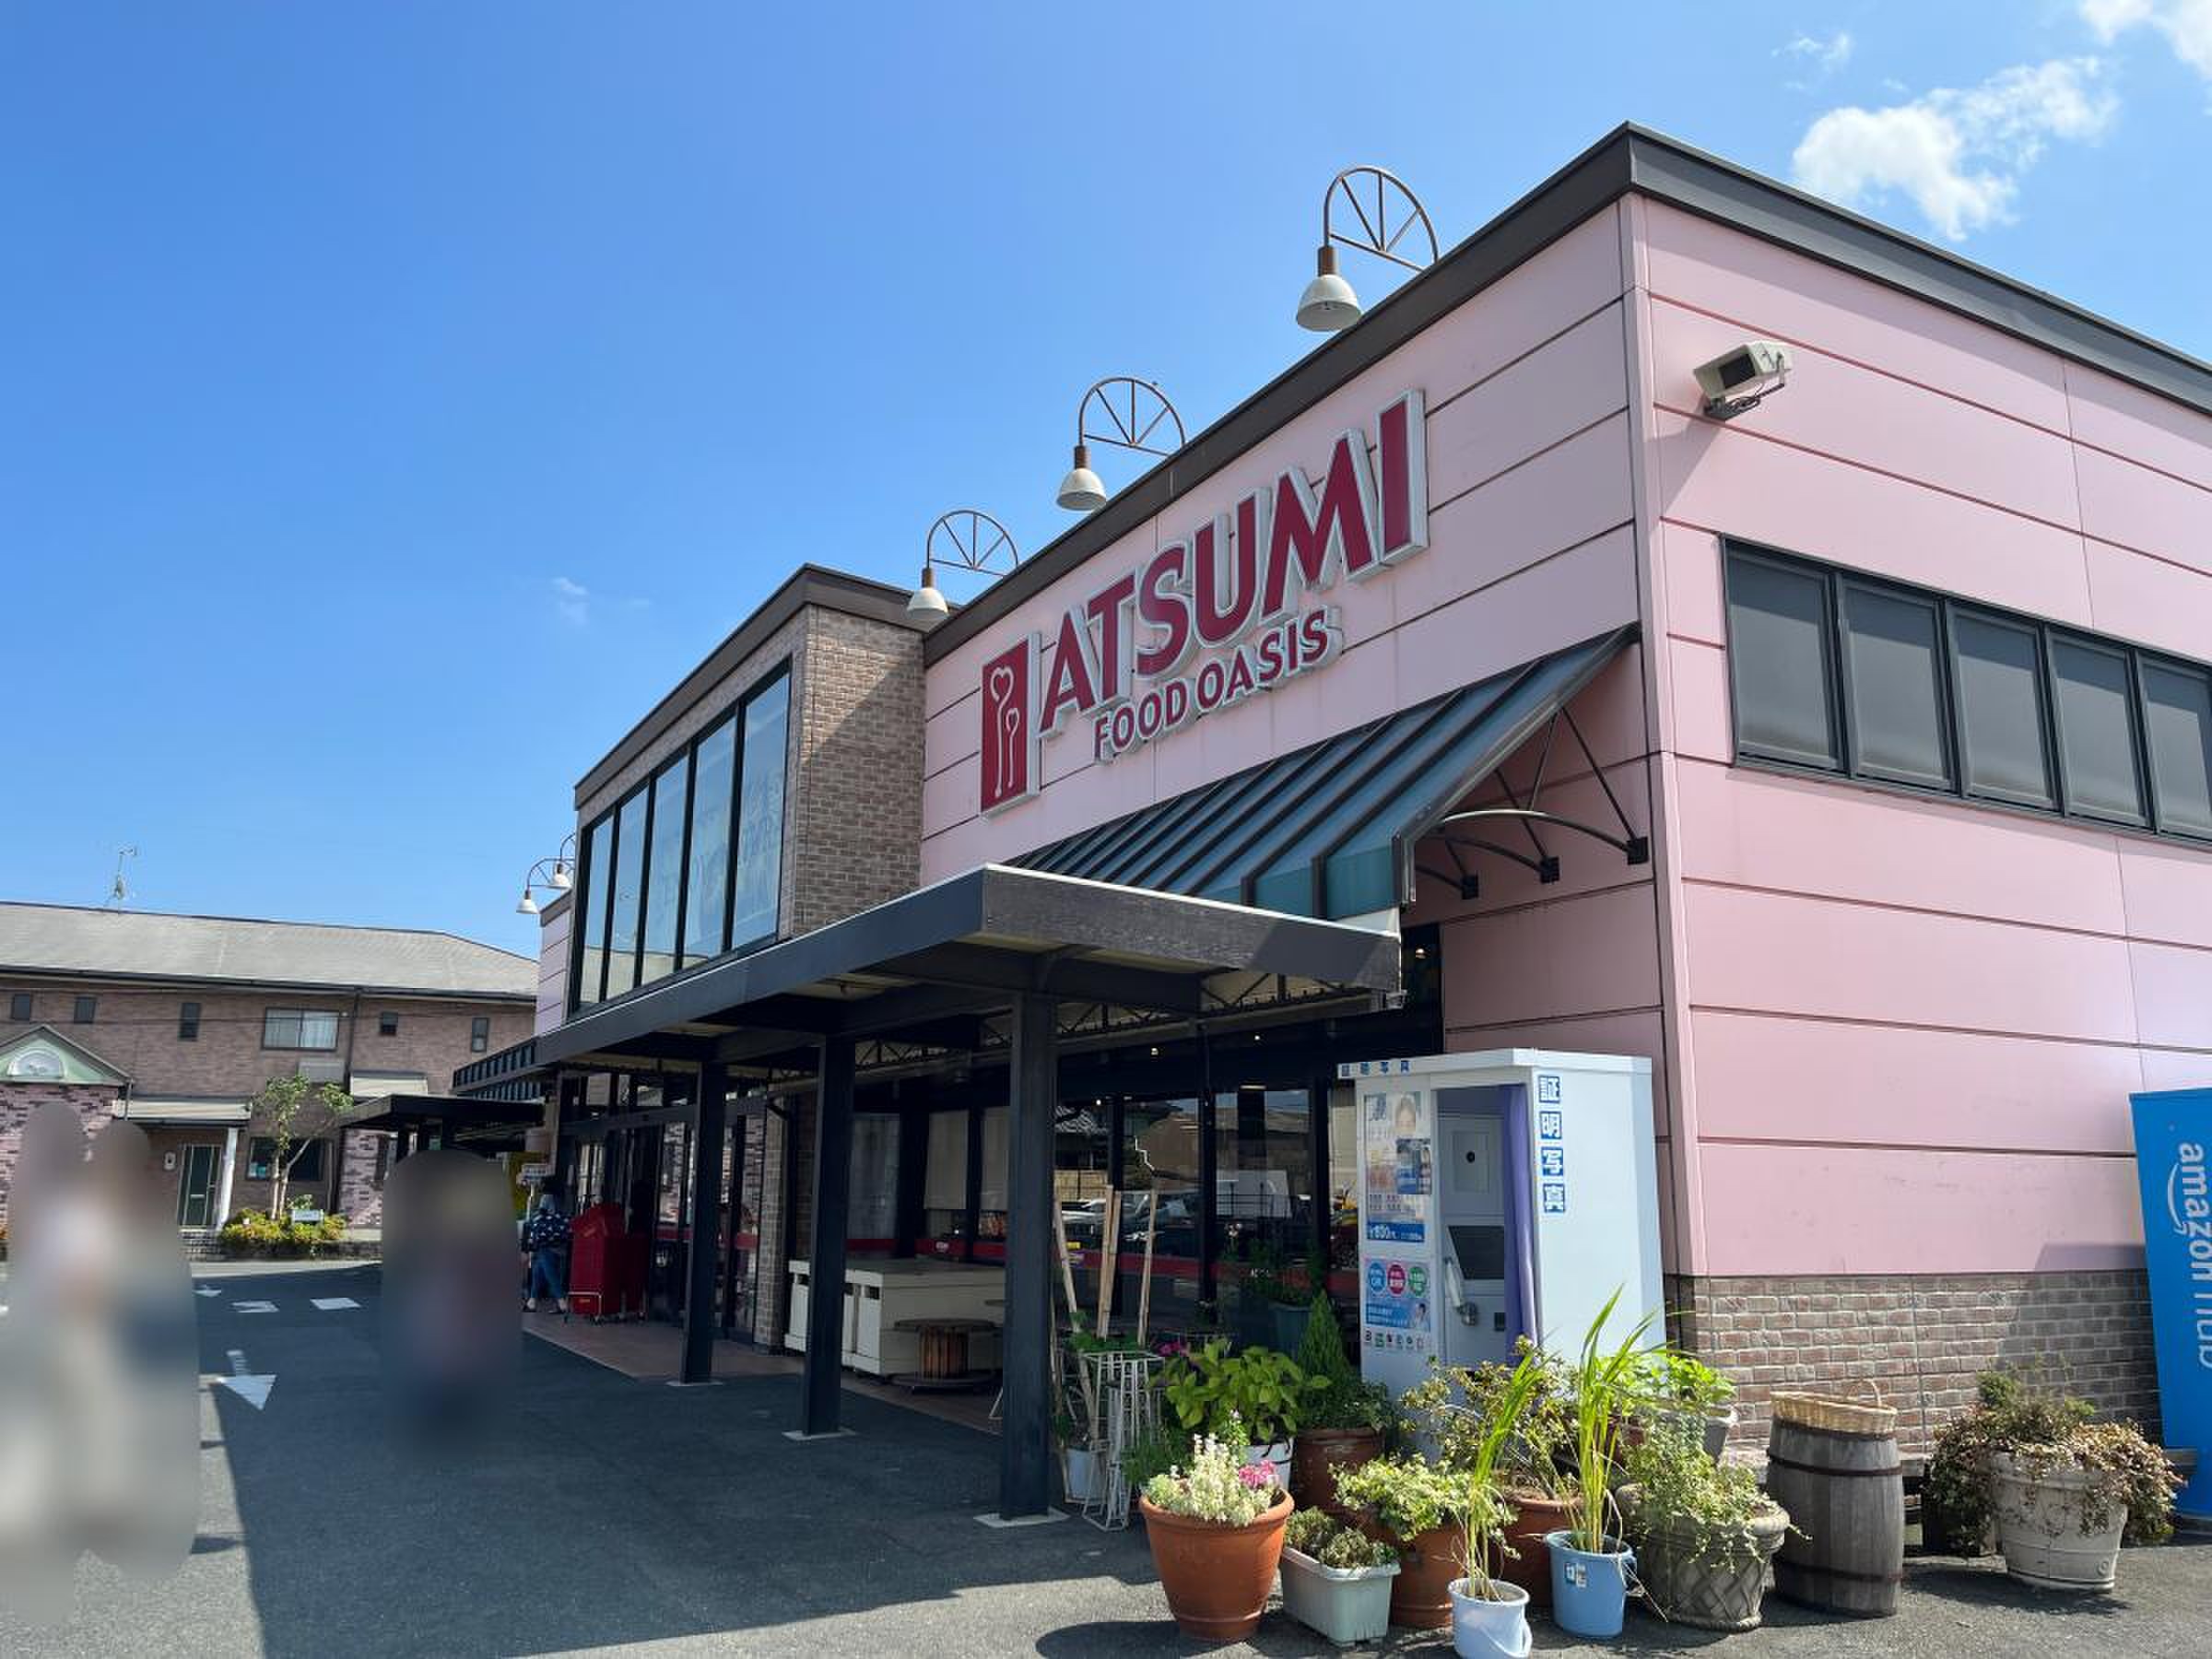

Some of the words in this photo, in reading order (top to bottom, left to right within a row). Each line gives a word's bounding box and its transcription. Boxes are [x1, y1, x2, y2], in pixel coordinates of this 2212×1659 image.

[1037, 391, 1425, 738] ATSUMI
[1093, 678, 1191, 764] FOOD
[1197, 606, 1336, 712] OASIS
[1538, 1076, 1565, 1212] 証明写真
[2179, 1142, 2212, 1282] amazon
